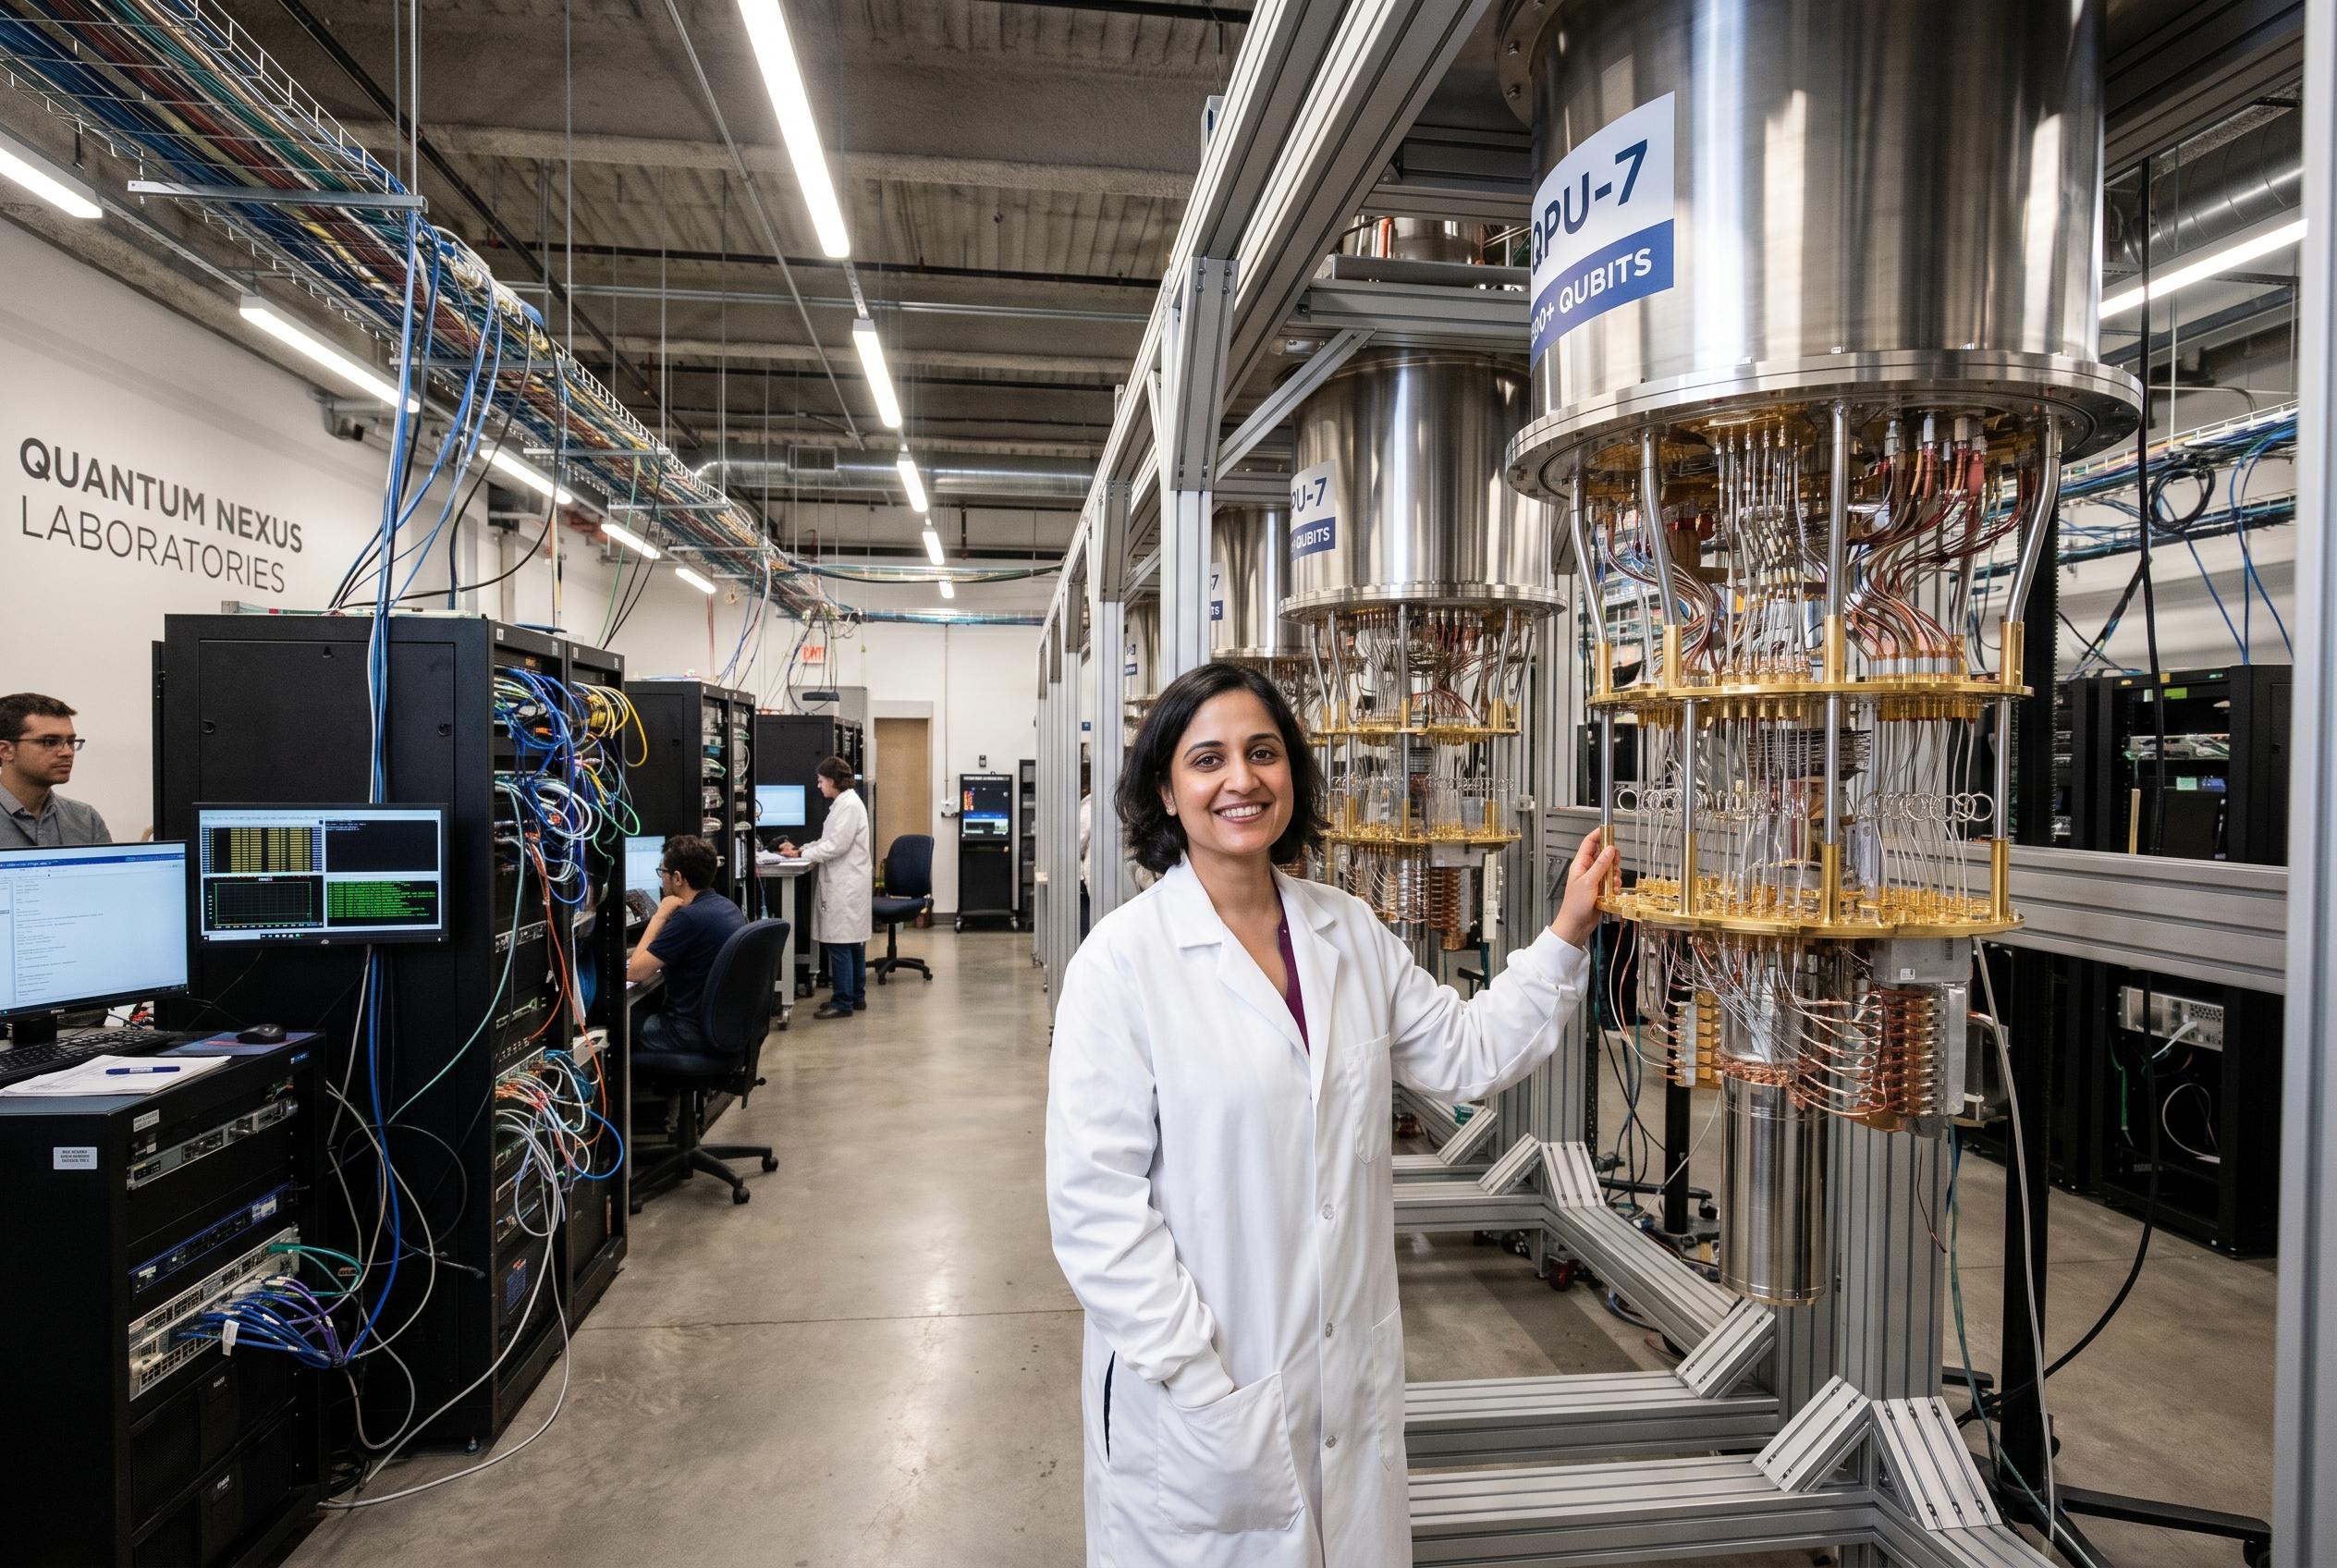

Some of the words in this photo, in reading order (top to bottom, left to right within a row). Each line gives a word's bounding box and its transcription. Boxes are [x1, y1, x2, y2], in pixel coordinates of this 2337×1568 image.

[1532, 139, 1647, 276] QPU-7
[1560, 248, 1652, 314] QUBITS
[20, 437, 204, 525] QUANTUM
[217, 498, 302, 553] NEXUS
[22, 495, 285, 594] LABORATORIES
[1297, 527, 1329, 549] QUBITS
